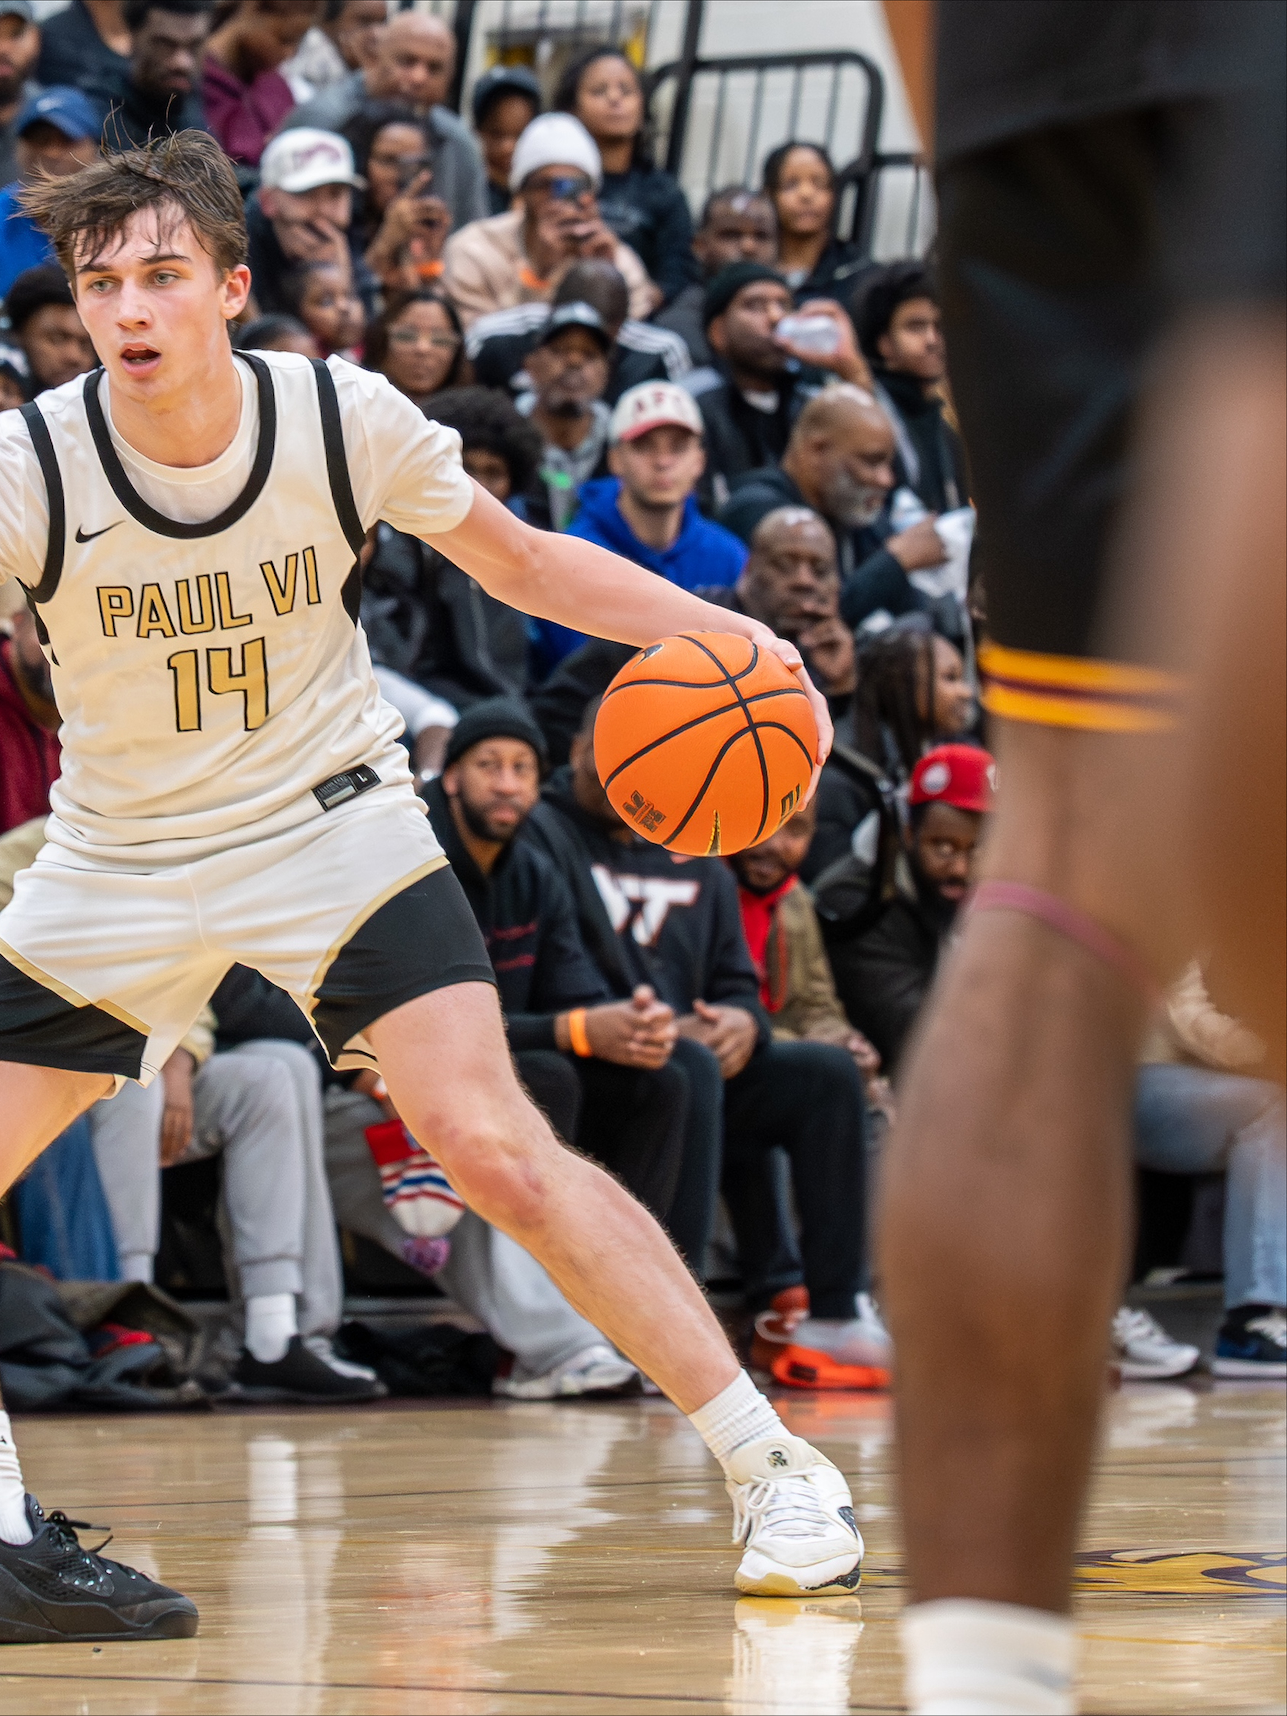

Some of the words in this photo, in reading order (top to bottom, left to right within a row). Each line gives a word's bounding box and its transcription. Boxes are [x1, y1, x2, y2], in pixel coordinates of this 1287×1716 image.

[96, 571, 253, 638] PAUL
[259, 545, 322, 616] VI
[167, 636, 269, 732] 14
